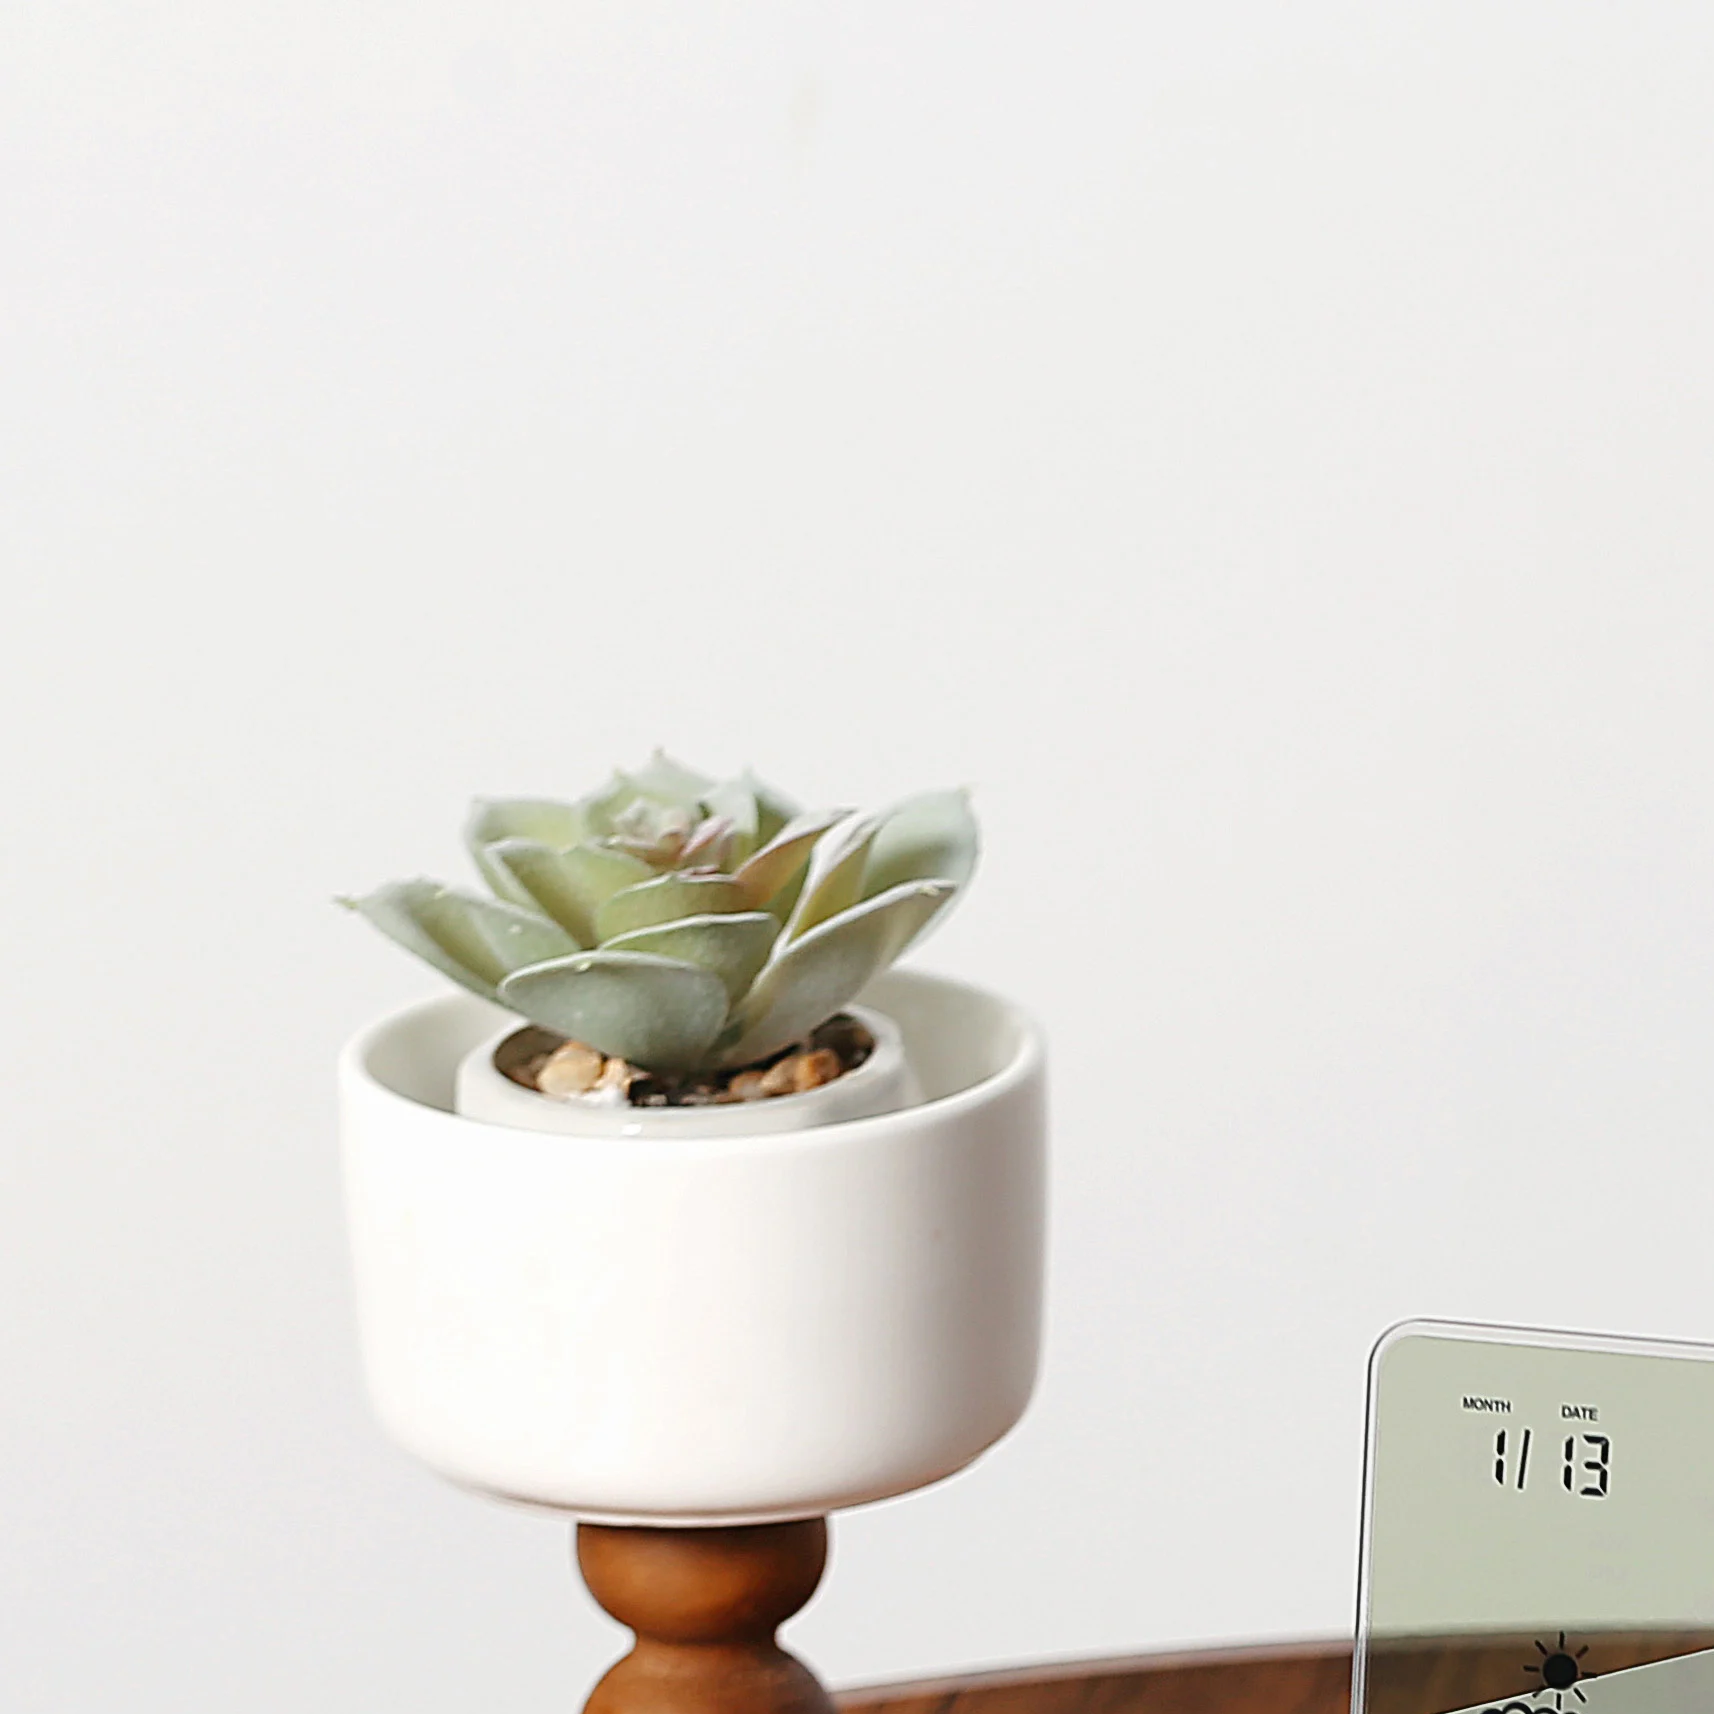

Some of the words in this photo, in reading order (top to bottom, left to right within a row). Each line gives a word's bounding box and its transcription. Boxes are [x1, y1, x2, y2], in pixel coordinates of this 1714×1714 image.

[1462, 1396, 1512, 1413] MONTH
[1561, 1405, 1599, 1421] DATE
[1563, 1434, 1610, 1497] 13
